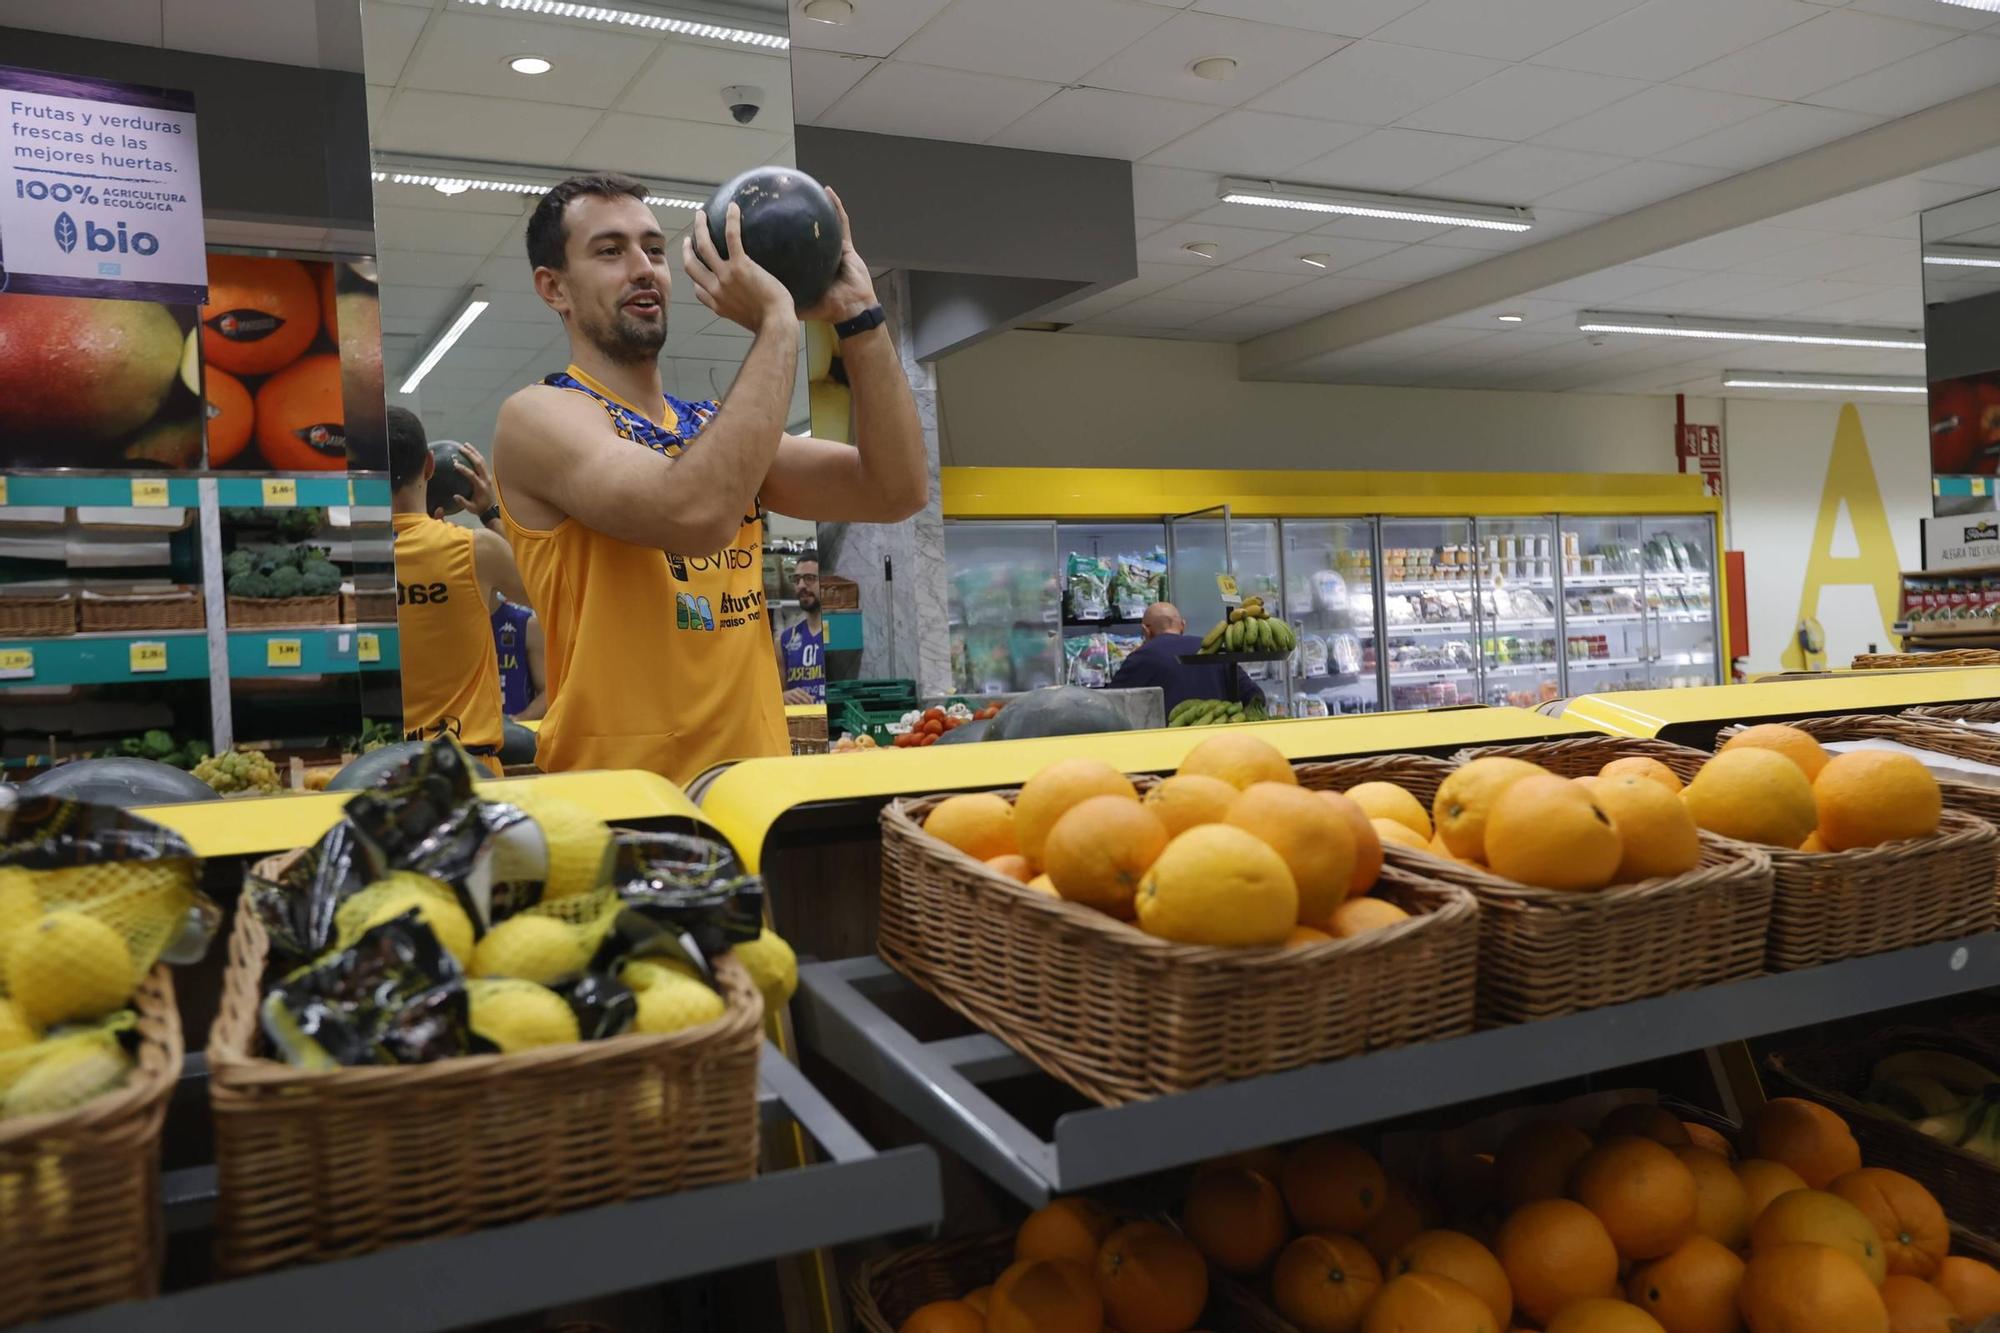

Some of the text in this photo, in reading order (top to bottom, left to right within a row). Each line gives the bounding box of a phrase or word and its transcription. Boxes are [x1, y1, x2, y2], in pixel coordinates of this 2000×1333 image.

[11, 102, 182, 134] Frutas y verduras
[12, 123, 148, 150] frescas de las
[14, 145, 178, 173] mejores huertas.
[16, 179, 99, 205] 100%
[103, 188, 187, 203] AGRICULTURA
[85, 220, 159, 256] bio
